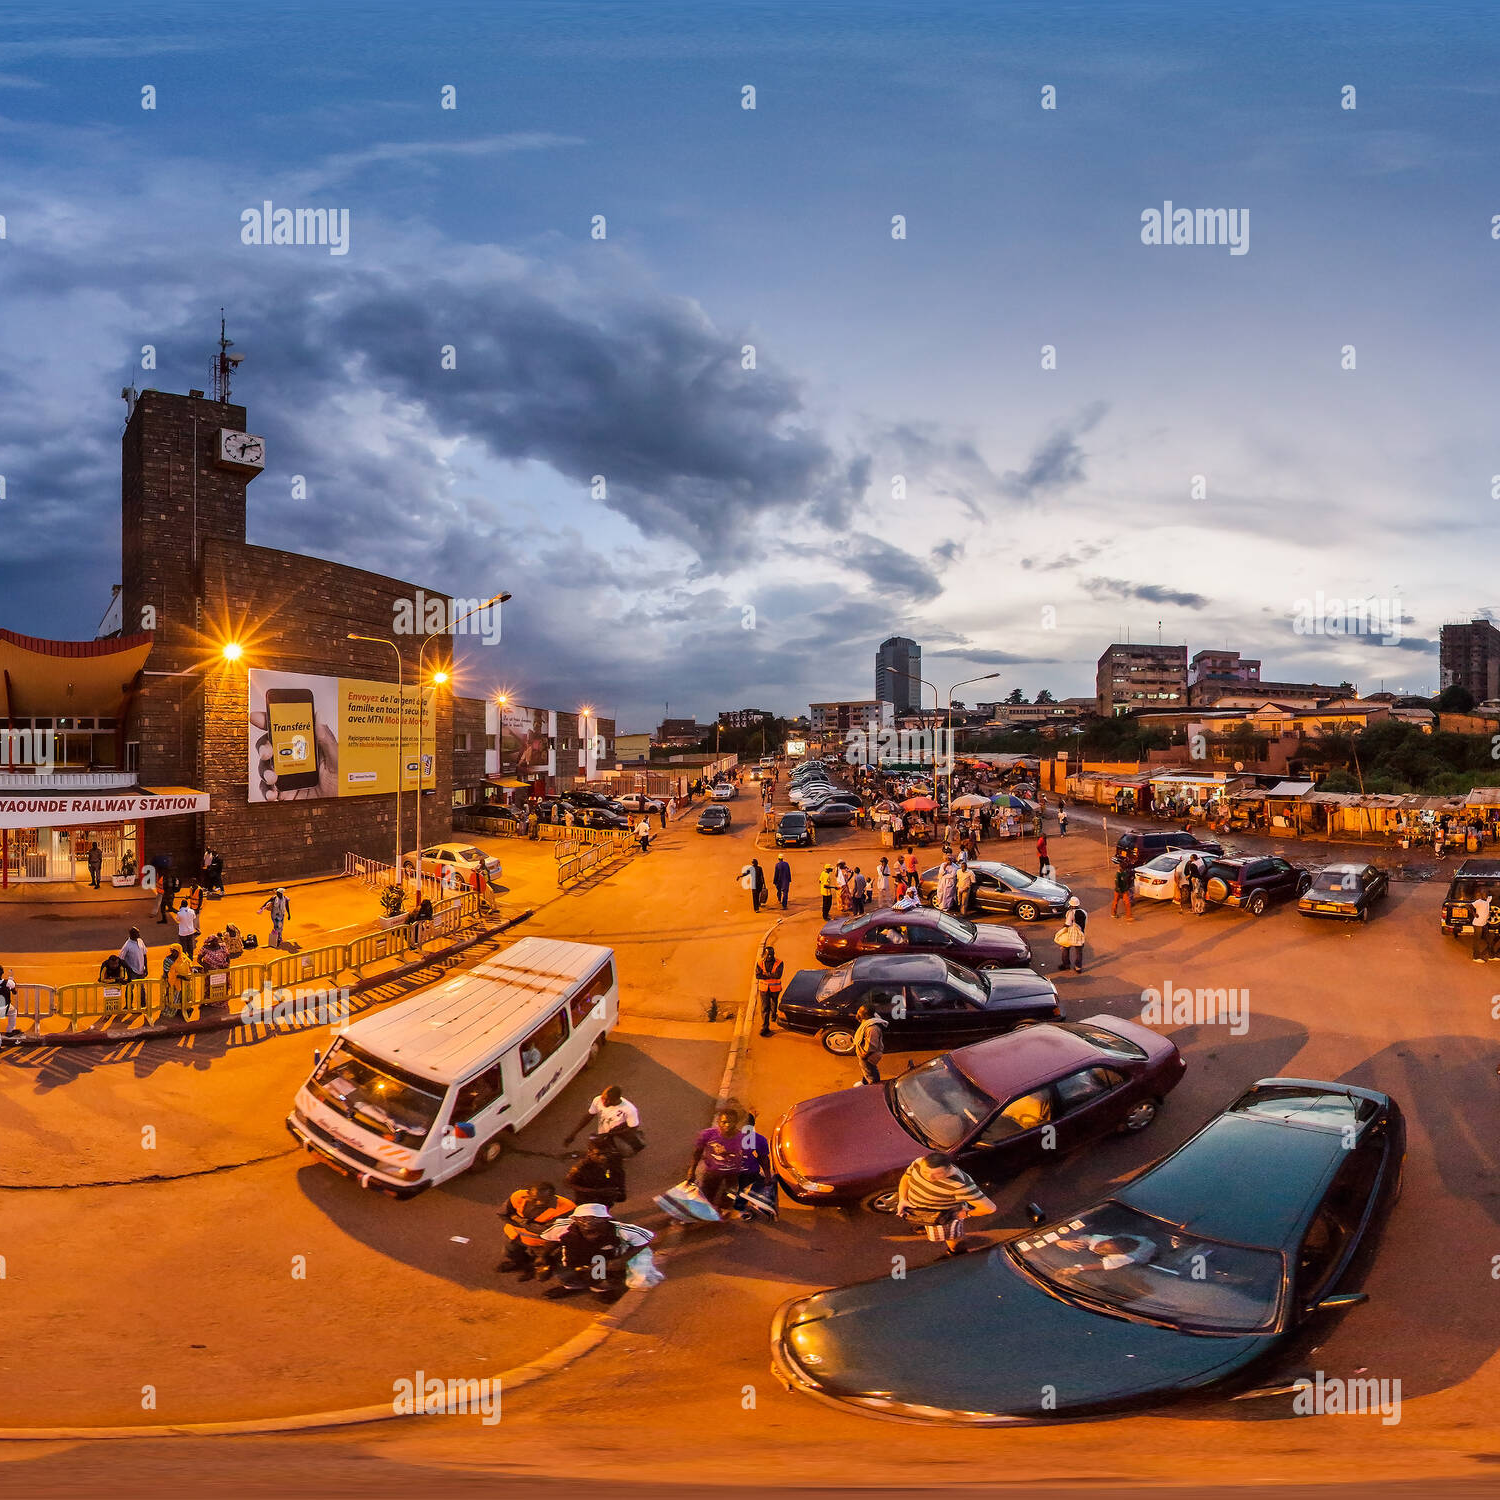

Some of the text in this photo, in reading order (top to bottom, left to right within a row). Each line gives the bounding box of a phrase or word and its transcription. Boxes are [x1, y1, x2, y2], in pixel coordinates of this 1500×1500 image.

[348, 692, 380, 703] Envoyez
[380, 694, 389, 702] de
[348, 702, 375, 713] famille
[376, 706, 386, 714] en
[273, 721, 311, 732] Transféré
[348, 715, 430, 727] avec MTN Moble Moey
[71, 799, 137, 812] RAILWAY
[139, 797, 198, 811] STATION
